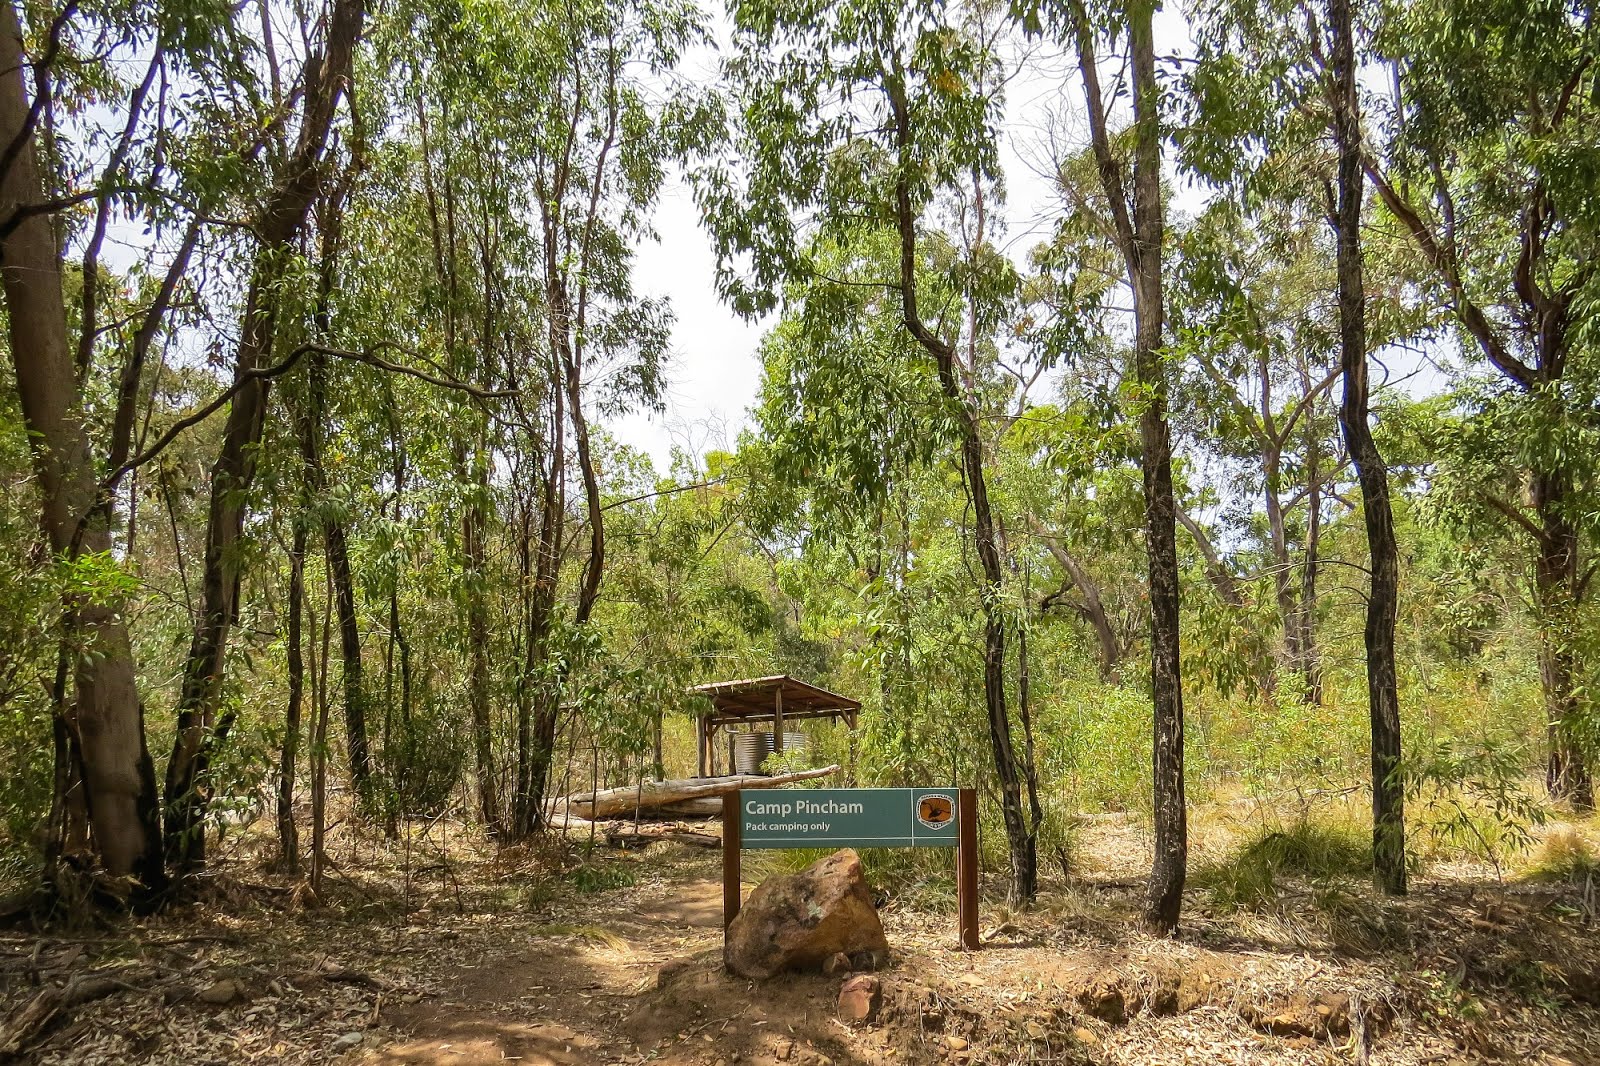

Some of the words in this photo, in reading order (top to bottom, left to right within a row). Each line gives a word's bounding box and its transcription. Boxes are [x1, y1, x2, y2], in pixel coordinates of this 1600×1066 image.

[745, 800, 792, 817] Camp
[796, 799, 863, 814] Pincham
[745, 822, 767, 831] Pack
[769, 821, 808, 832] camping
[810, 821, 830, 832] only
